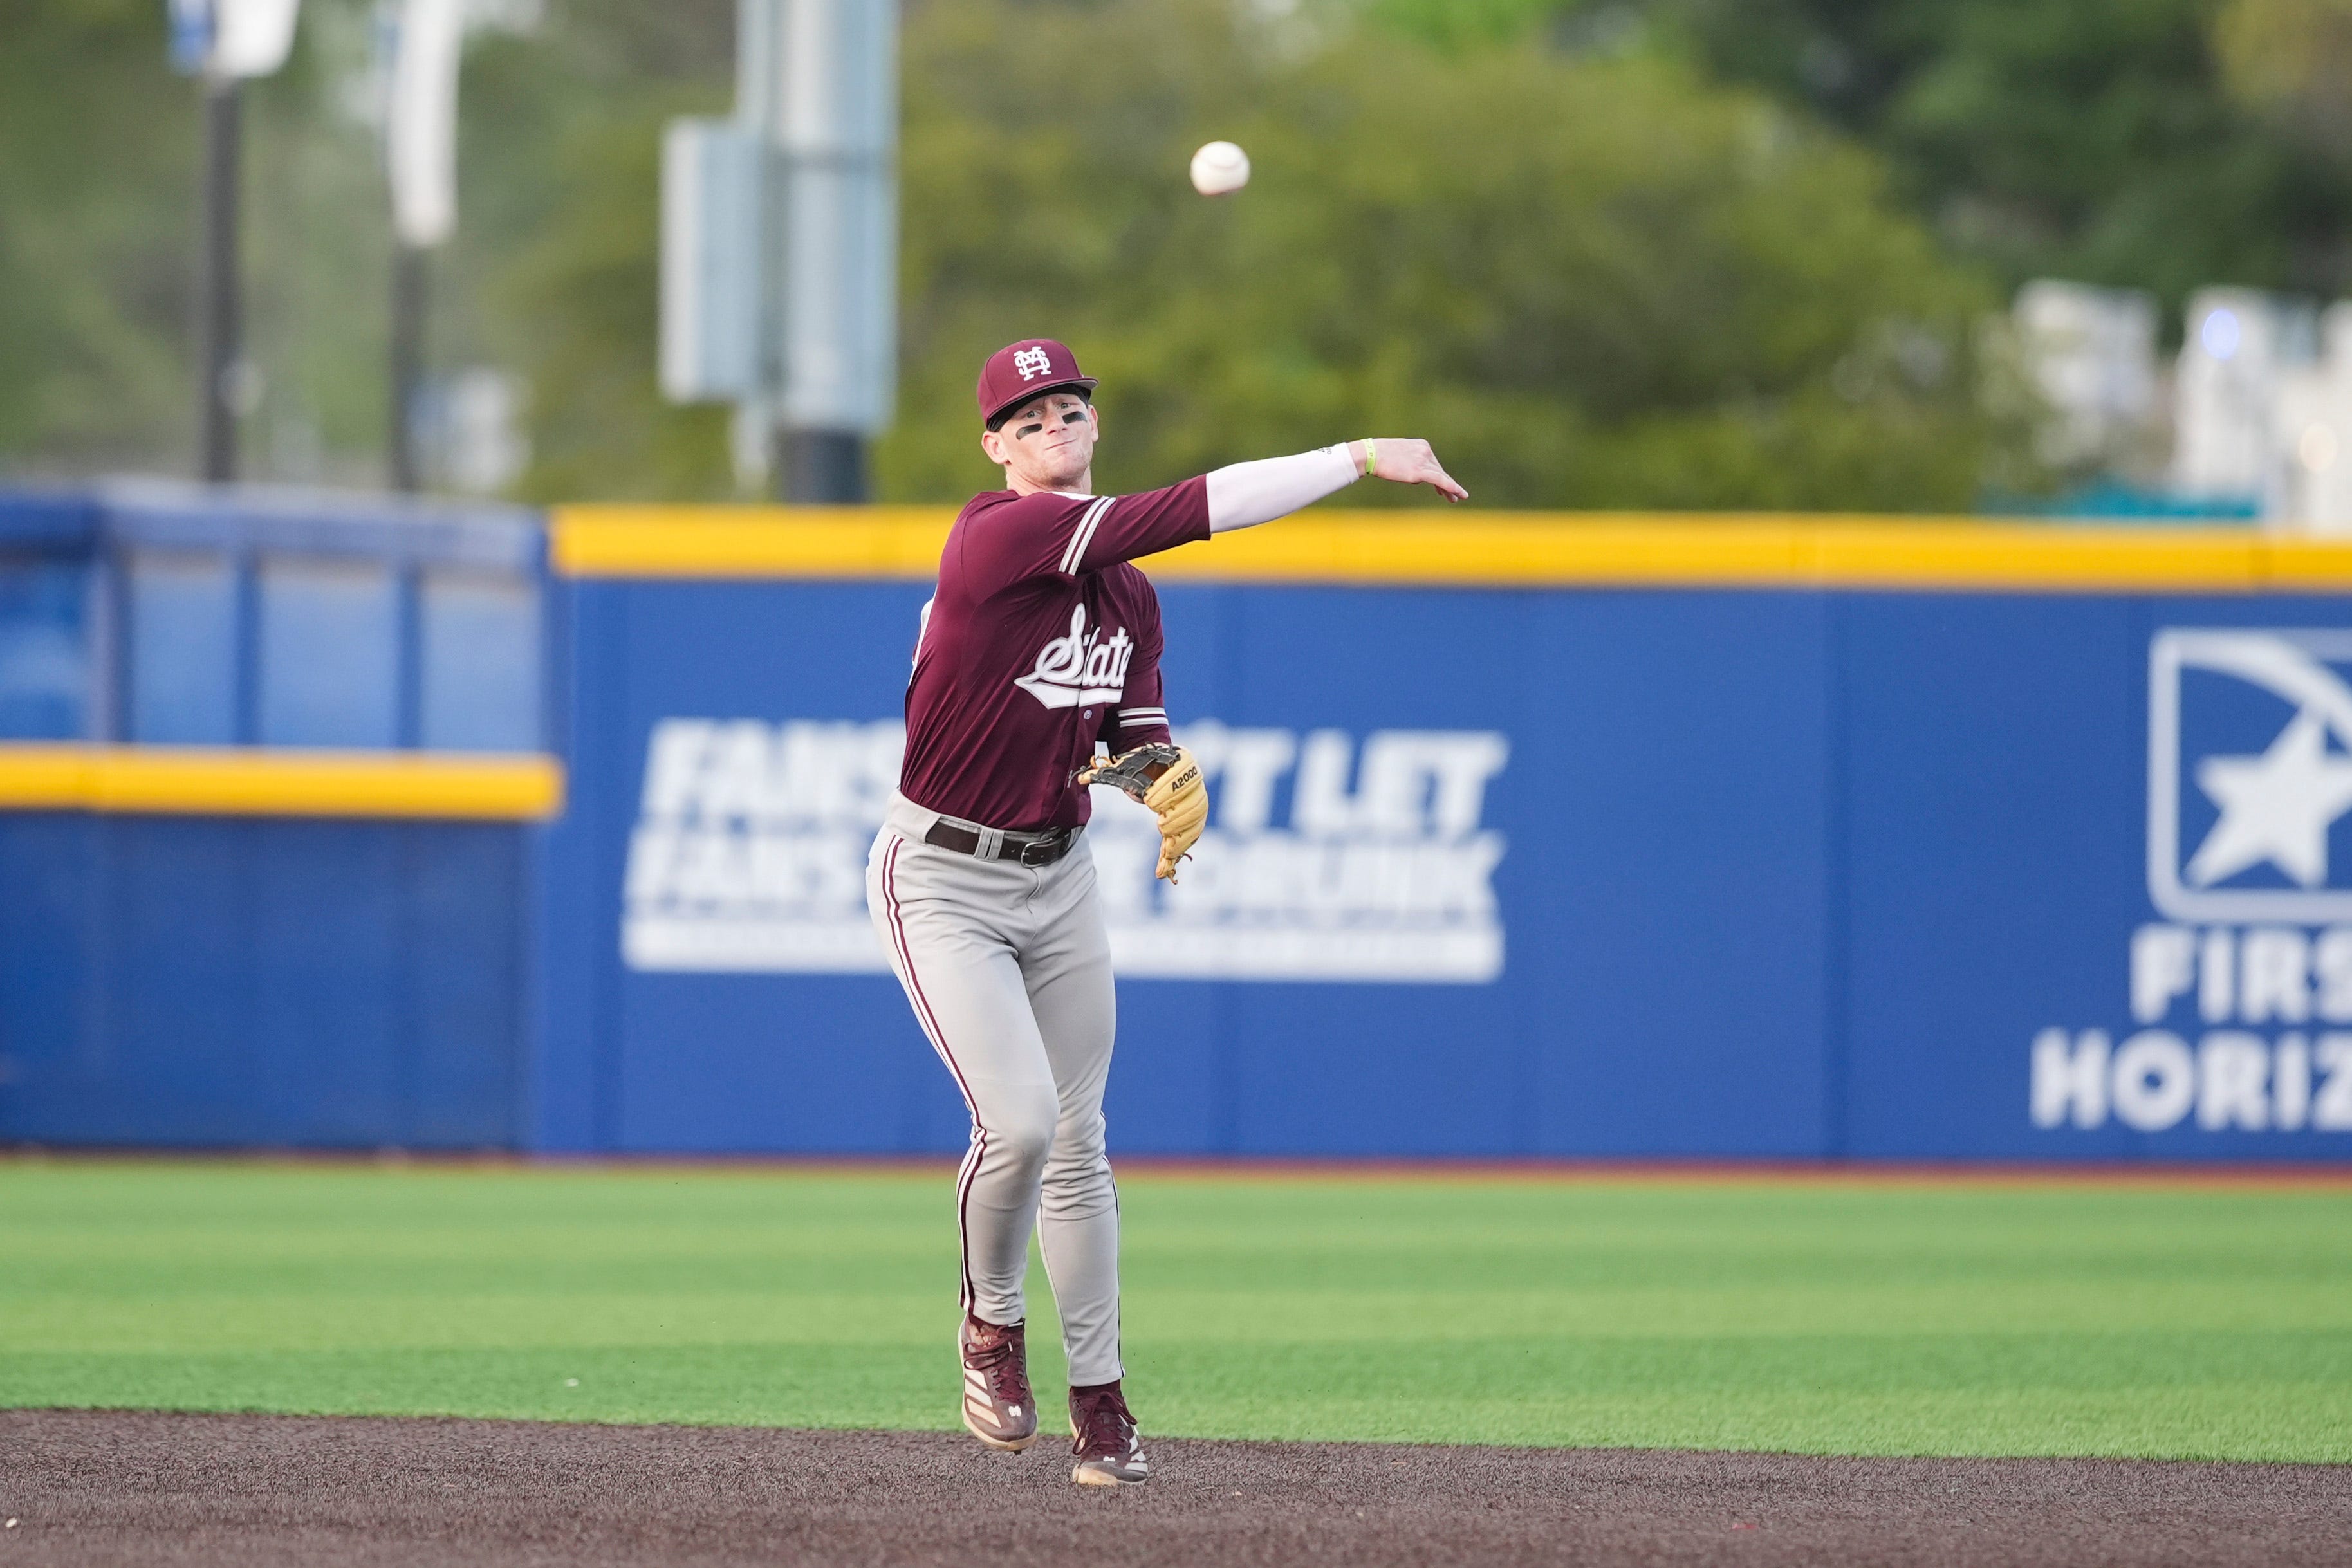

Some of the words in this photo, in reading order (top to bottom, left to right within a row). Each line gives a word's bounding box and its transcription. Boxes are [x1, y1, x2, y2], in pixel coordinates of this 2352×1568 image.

[1014, 602, 1134, 688] State
[1172, 766, 1198, 793] A2000
[1293, 728, 1508, 838] LET
